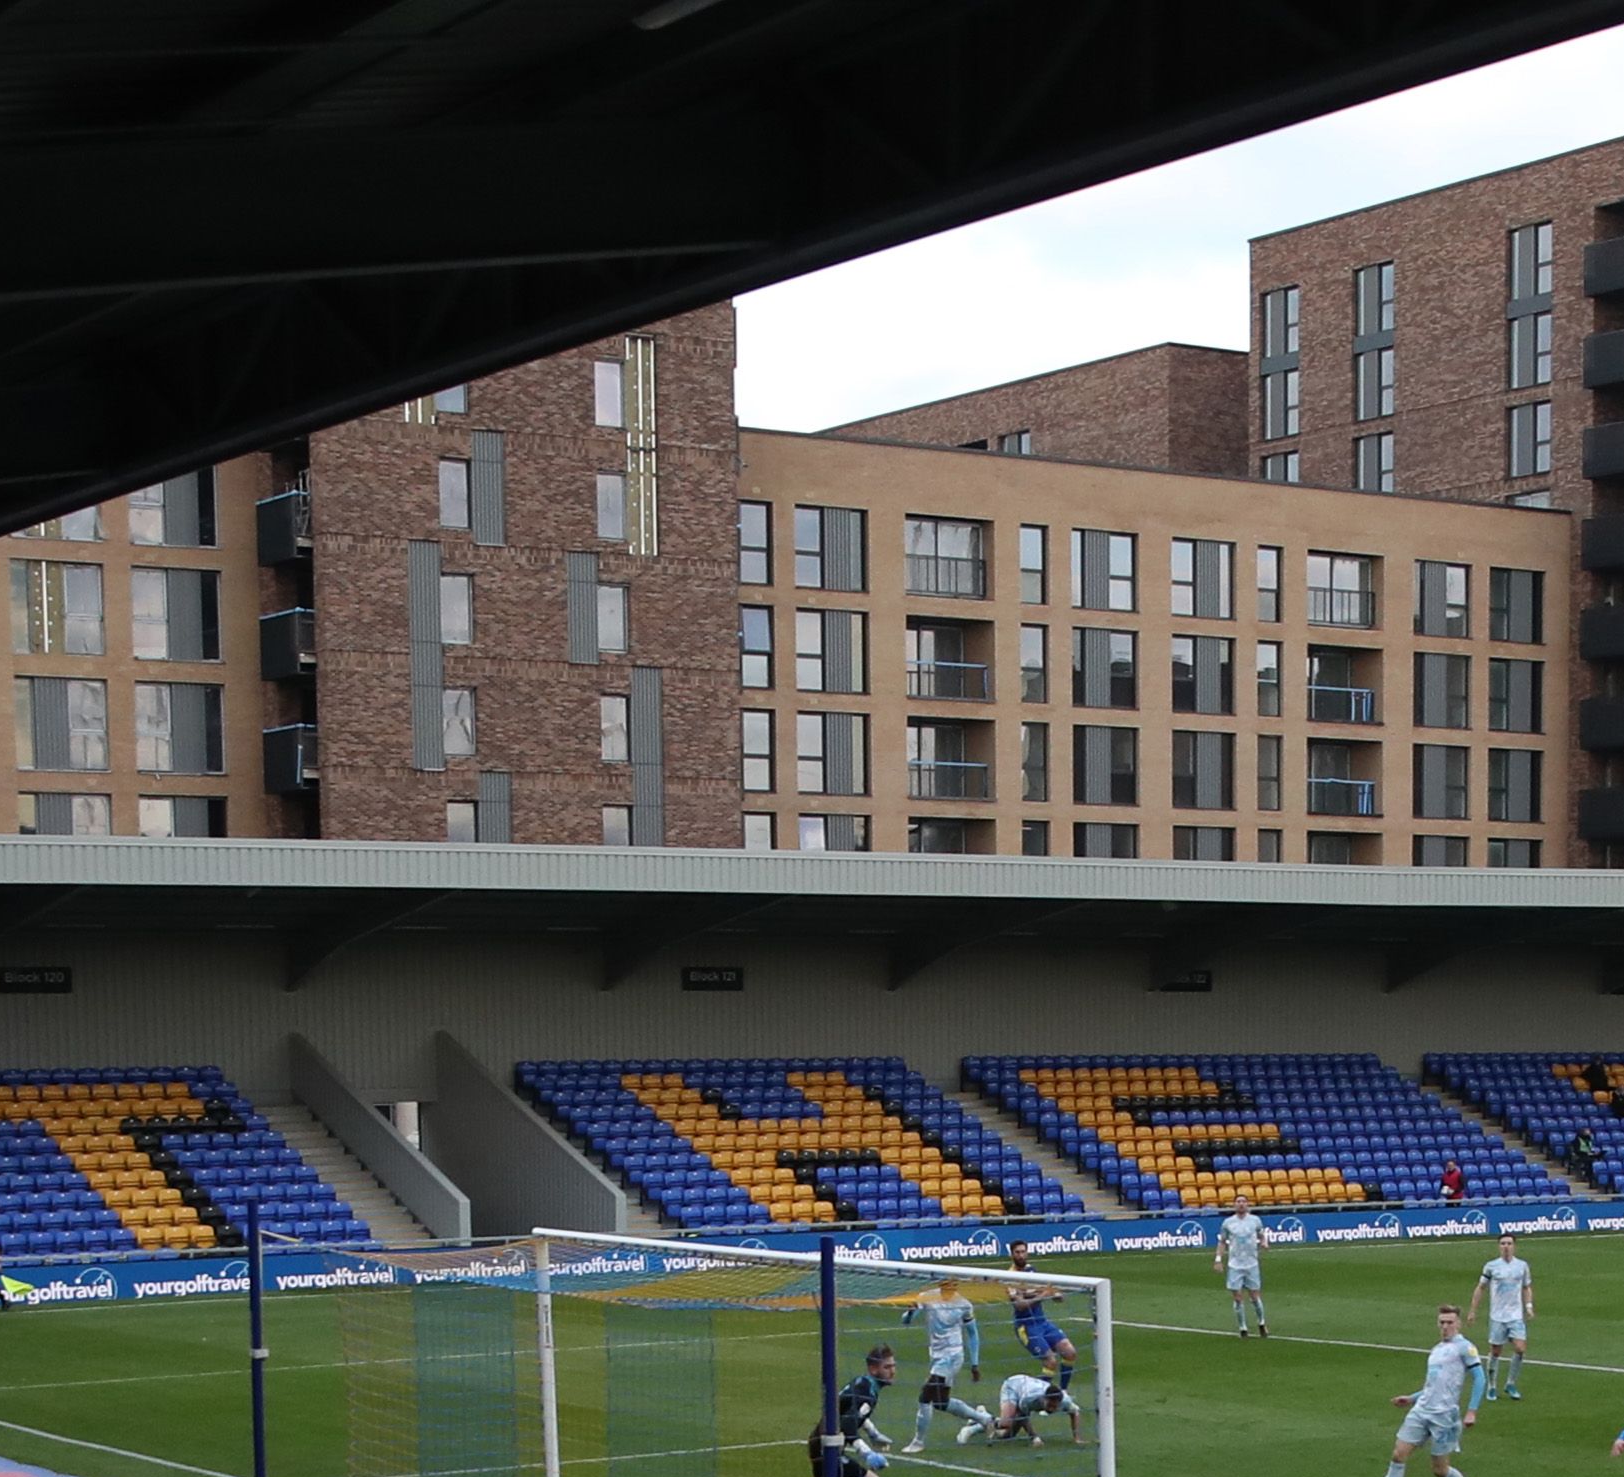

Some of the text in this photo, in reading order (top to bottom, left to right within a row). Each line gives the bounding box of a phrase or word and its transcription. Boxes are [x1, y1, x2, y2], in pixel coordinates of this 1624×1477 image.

[5, 973, 65, 984] Block 120
[688, 971, 719, 982] Block
[1316, 1222, 1401, 1243] yourgolftravel
[1406, 1217, 1488, 1238] yourgolftravel
[1499, 1214, 1578, 1234] yourgolftravel
[900, 1239, 998, 1260] yourgolftravel
[1113, 1229, 1204, 1252] yourgolftravel
[276, 1268, 395, 1291] yourgolftravel
